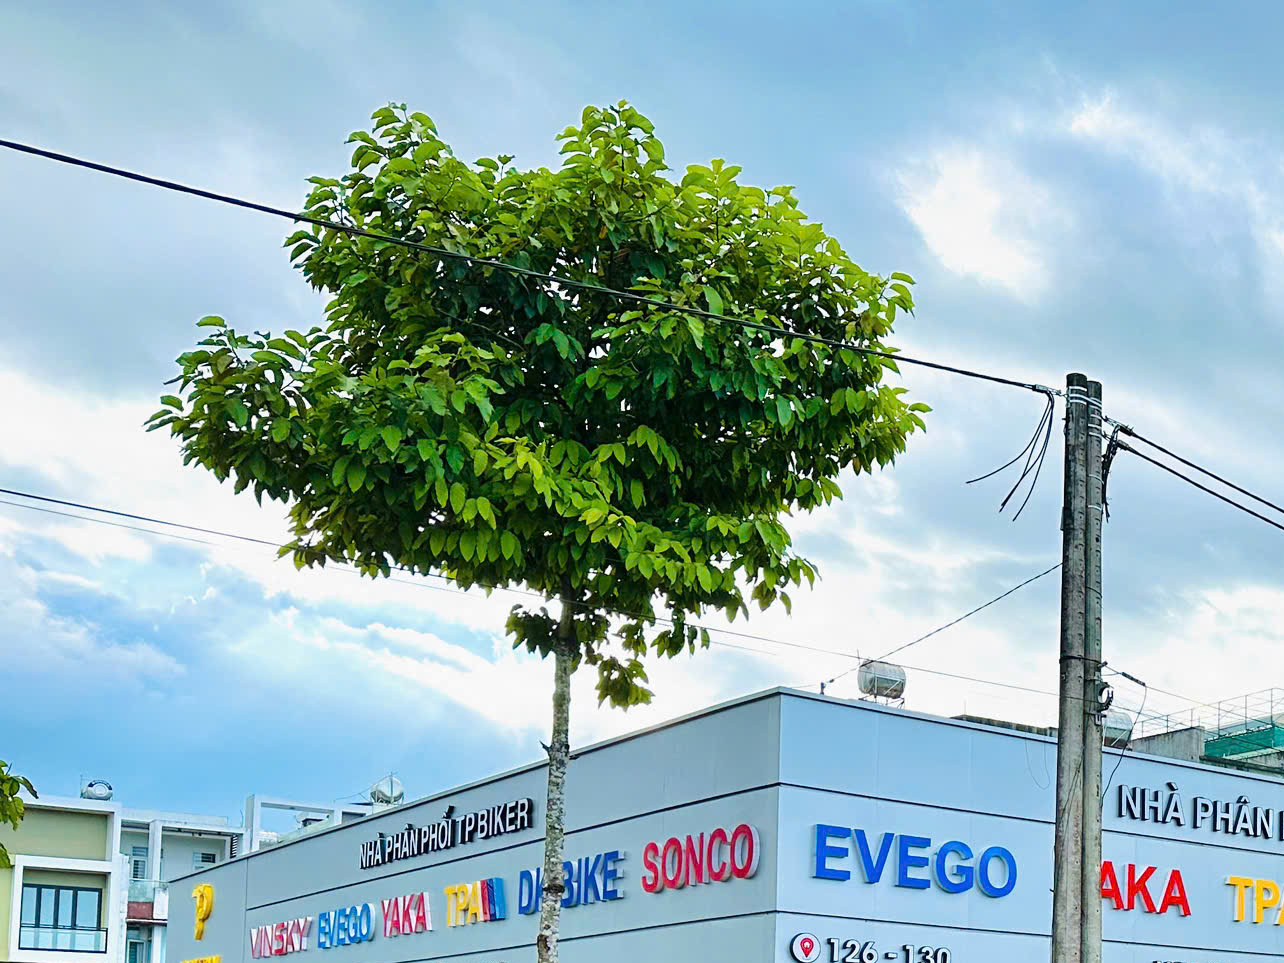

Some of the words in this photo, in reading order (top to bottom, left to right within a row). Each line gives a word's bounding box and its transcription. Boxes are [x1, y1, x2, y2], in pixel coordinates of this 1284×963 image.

[360, 833, 382, 869] NHÀ
[385, 823, 418, 862] PHÂN
[421, 806, 452, 853] PHỐI
[1118, 781, 1185, 826] NHÀ
[1194, 795, 1273, 839] PHÂN
[642, 824, 760, 893] SONCO
[813, 824, 1018, 898] EVEGO
[1101, 860, 1192, 916] AKA
[250, 917, 312, 959] VINSKY
[318, 903, 376, 949] EVEGO
[381, 892, 432, 937] YAKA
